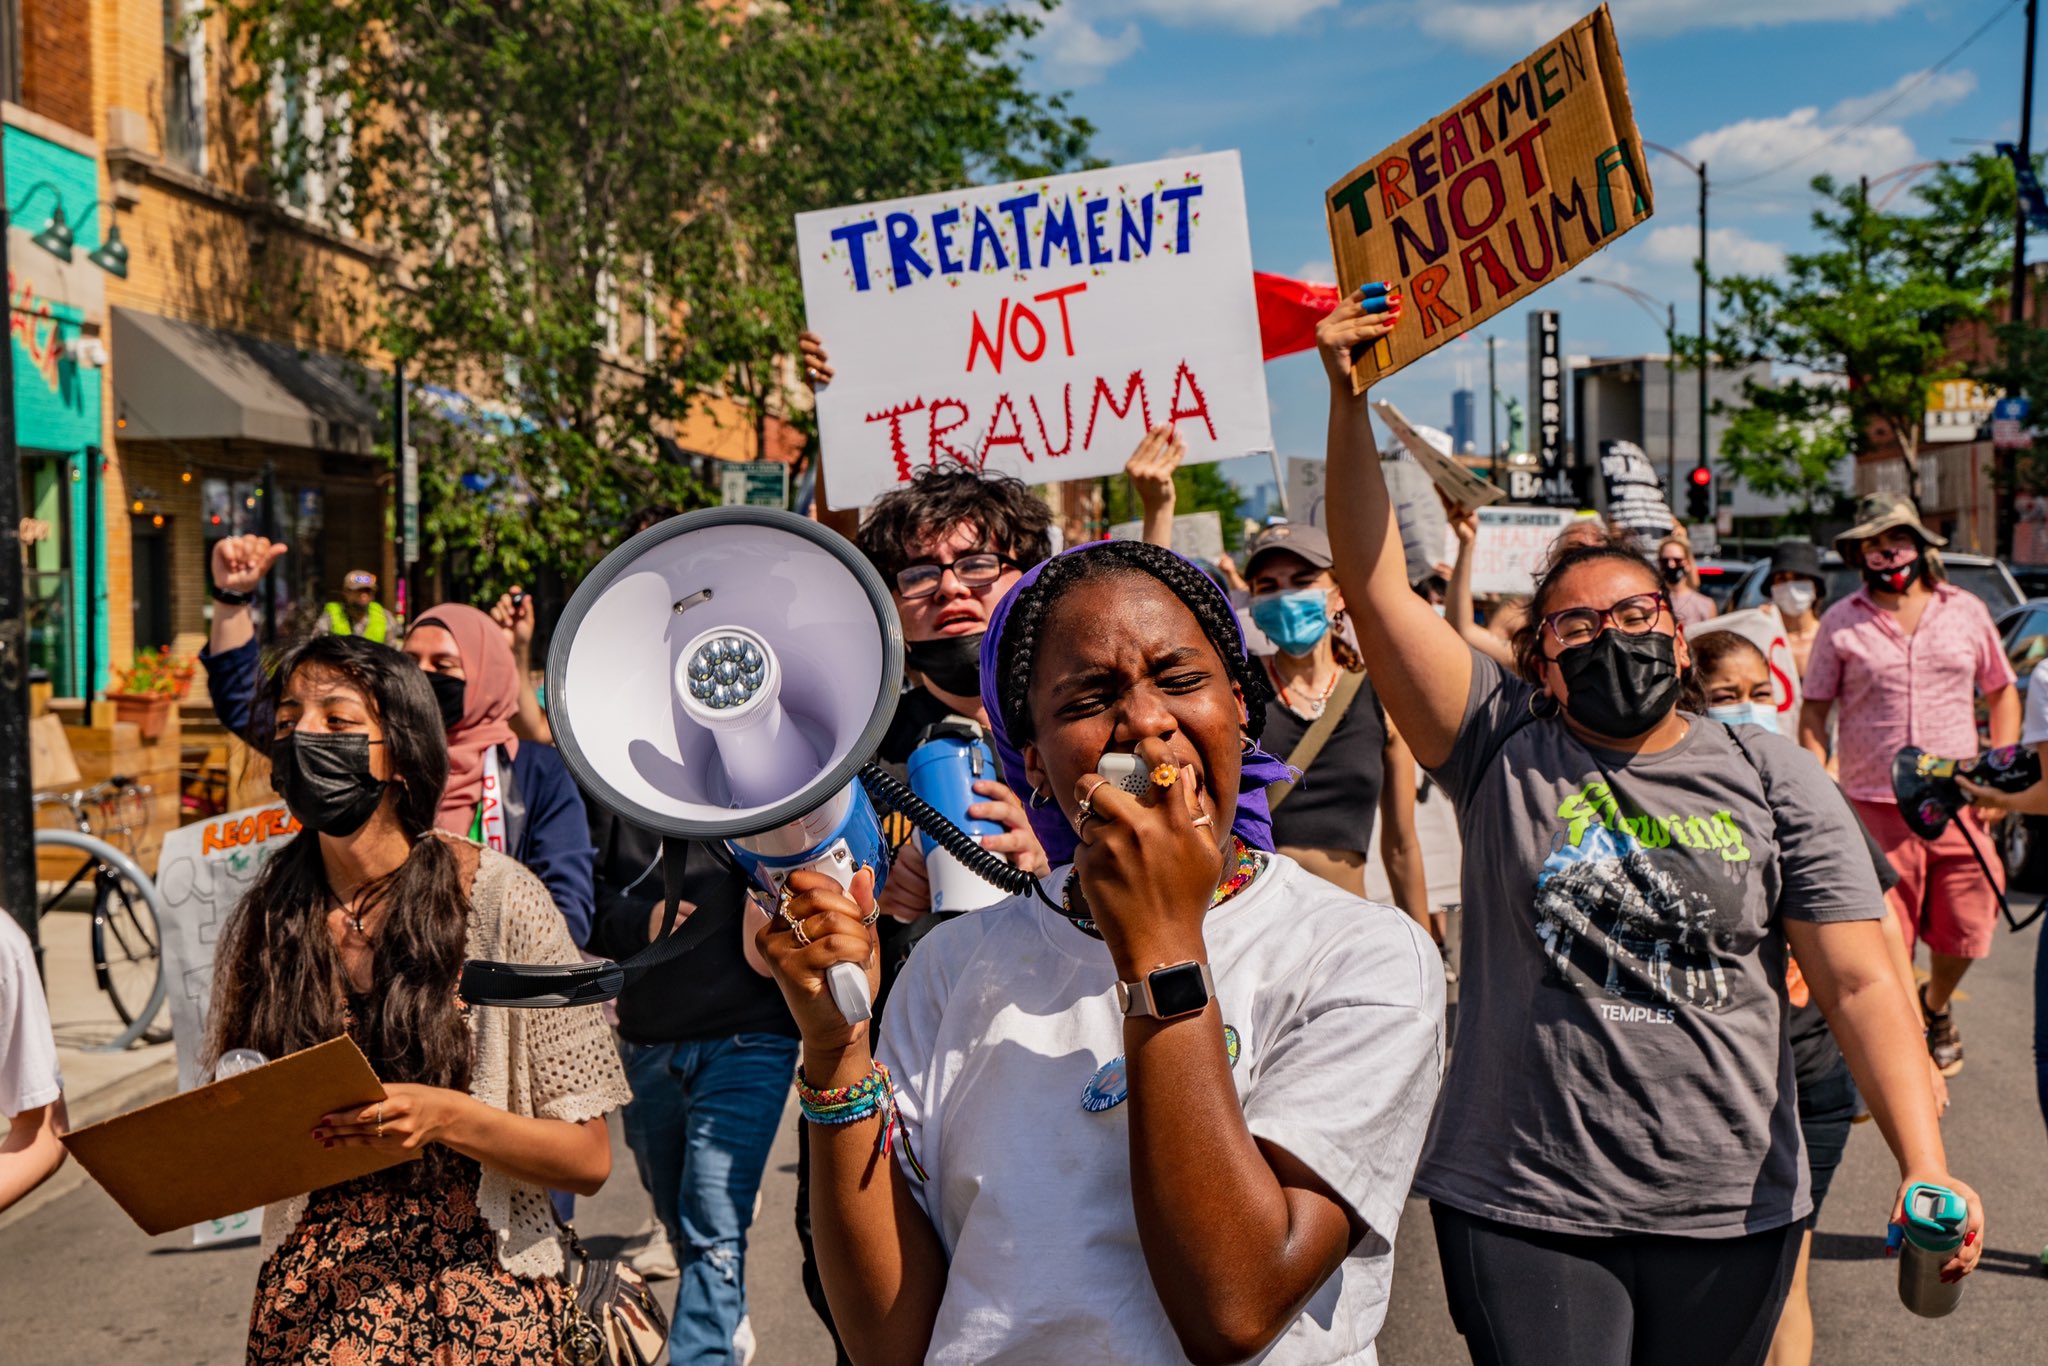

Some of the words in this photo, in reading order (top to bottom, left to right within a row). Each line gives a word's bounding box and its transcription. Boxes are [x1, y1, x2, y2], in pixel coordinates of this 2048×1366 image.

[831, 184, 1203, 292] TREATMENT
[1390, 118, 1551, 278] NOT
[966, 282, 1087, 374] NOT
[865, 358, 1217, 482] TRAUMA
[1541, 312, 1560, 467] LIBERTY
[1601, 1004, 1675, 1024] TEMPLES
